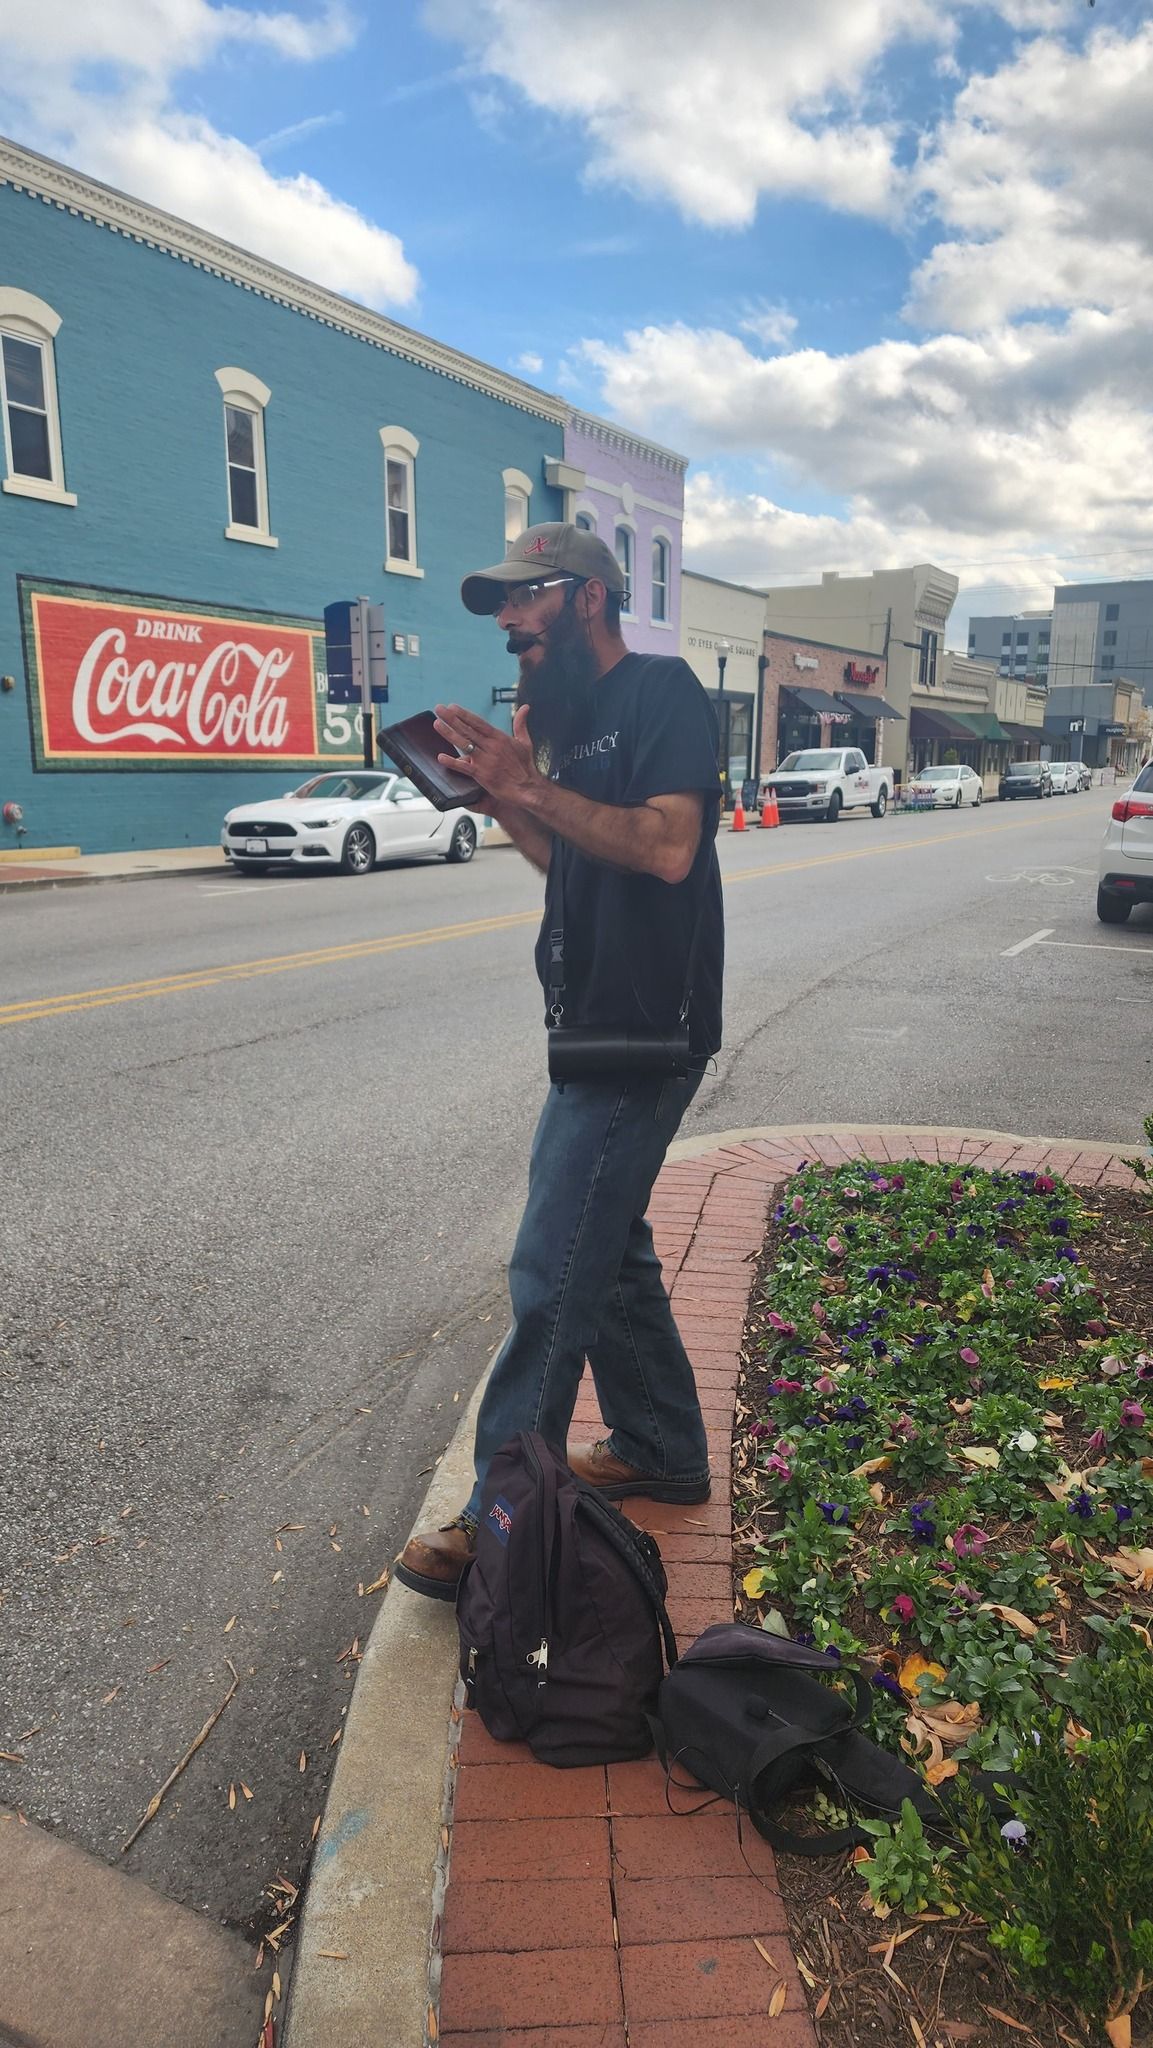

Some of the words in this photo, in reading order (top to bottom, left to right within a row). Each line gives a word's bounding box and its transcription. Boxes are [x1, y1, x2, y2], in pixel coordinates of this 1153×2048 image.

[135, 619, 203, 643] DRINK
[698, 639, 712, 649] EYES
[736, 645, 756, 657] SQUARE
[72, 627, 294, 747] Coca-Cola
